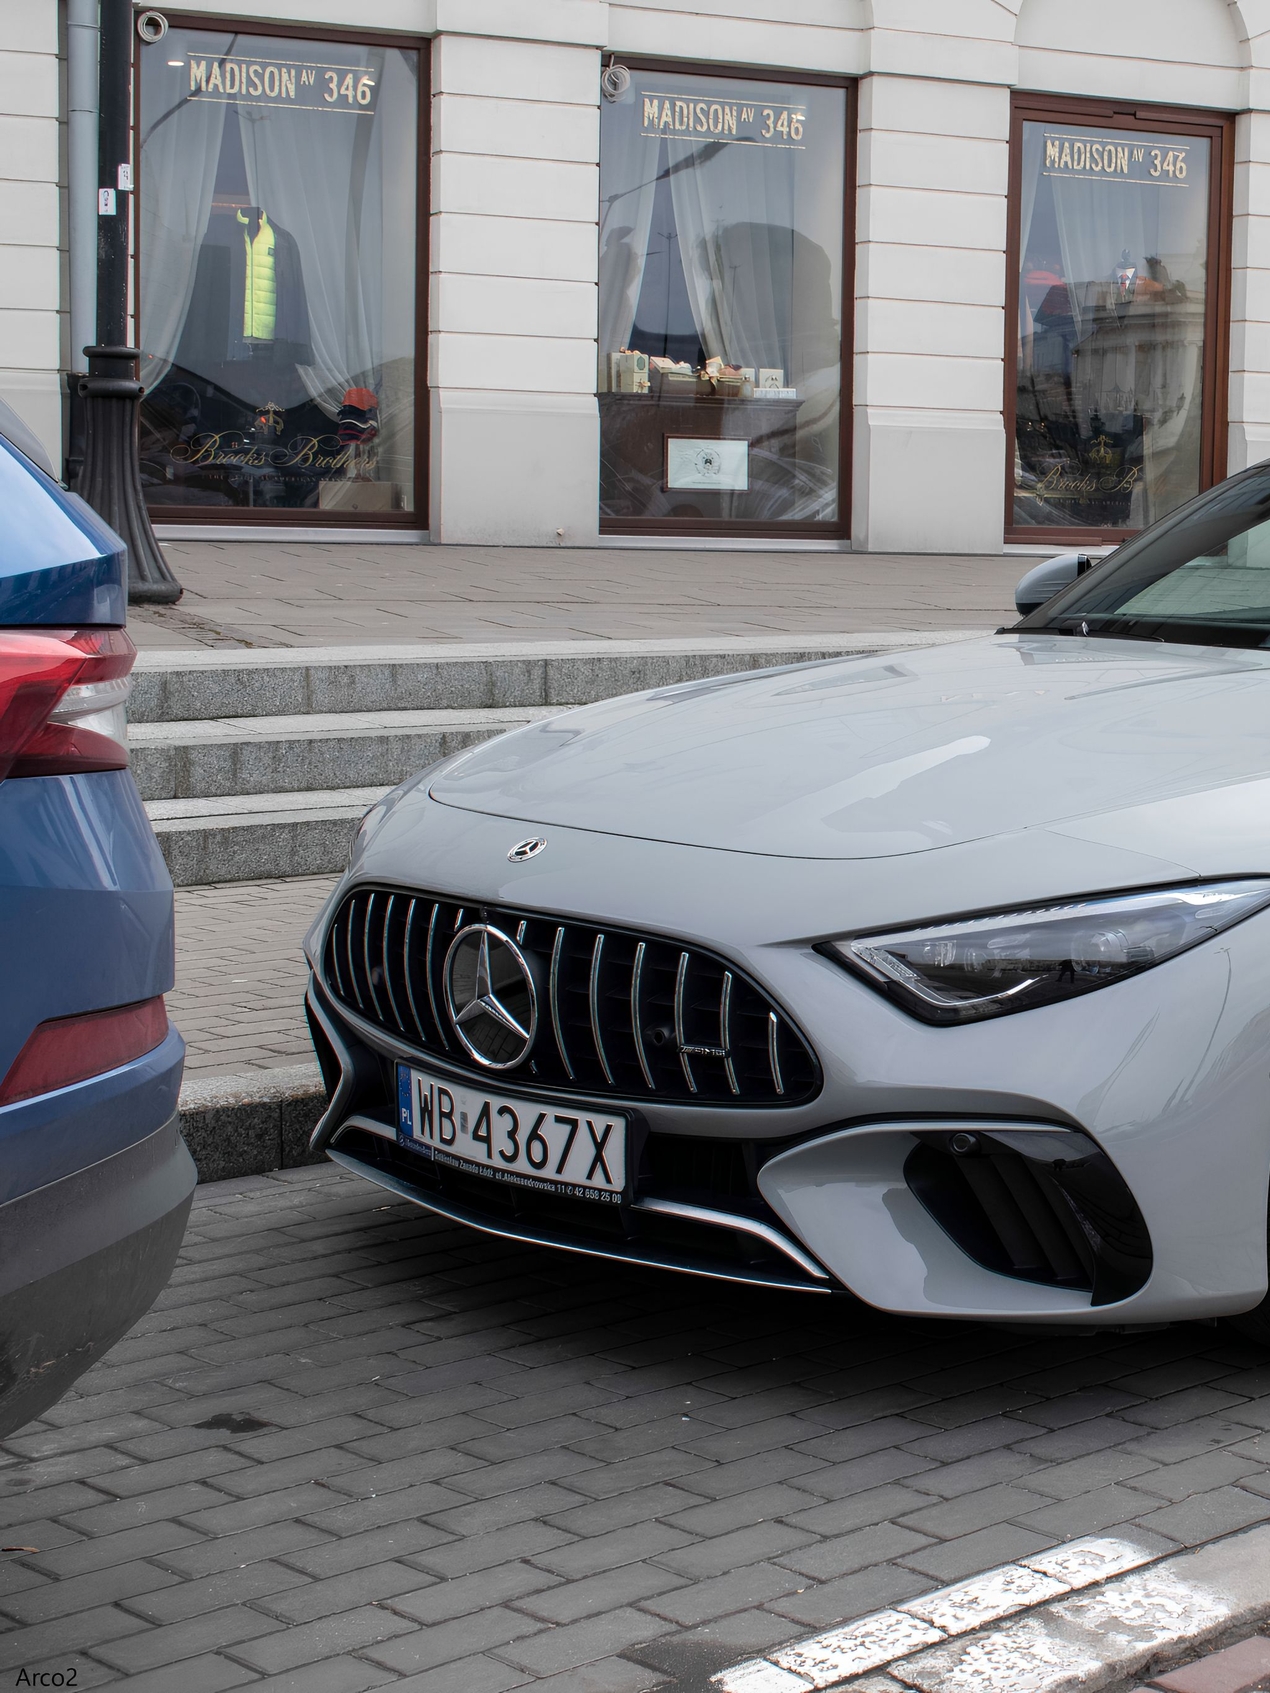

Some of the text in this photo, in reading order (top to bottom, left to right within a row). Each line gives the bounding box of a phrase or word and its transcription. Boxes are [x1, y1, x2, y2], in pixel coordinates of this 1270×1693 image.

[190, 60, 371, 105] MADISON AV 346
[643, 98, 804, 140] MADISON AV 346
[1046, 139, 1187, 179] MADISON AV 346
[171, 430, 378, 470] Brooks Brothers
[1036, 459, 1097, 492] Brooks
[401, 1107, 412, 1126] PL
[417, 1077, 615, 1185] WB 4367X
[557, 1183, 565, 1193] 11
[574, 1187, 584, 1197] 42
[600, 1191, 611, 1202] 25
